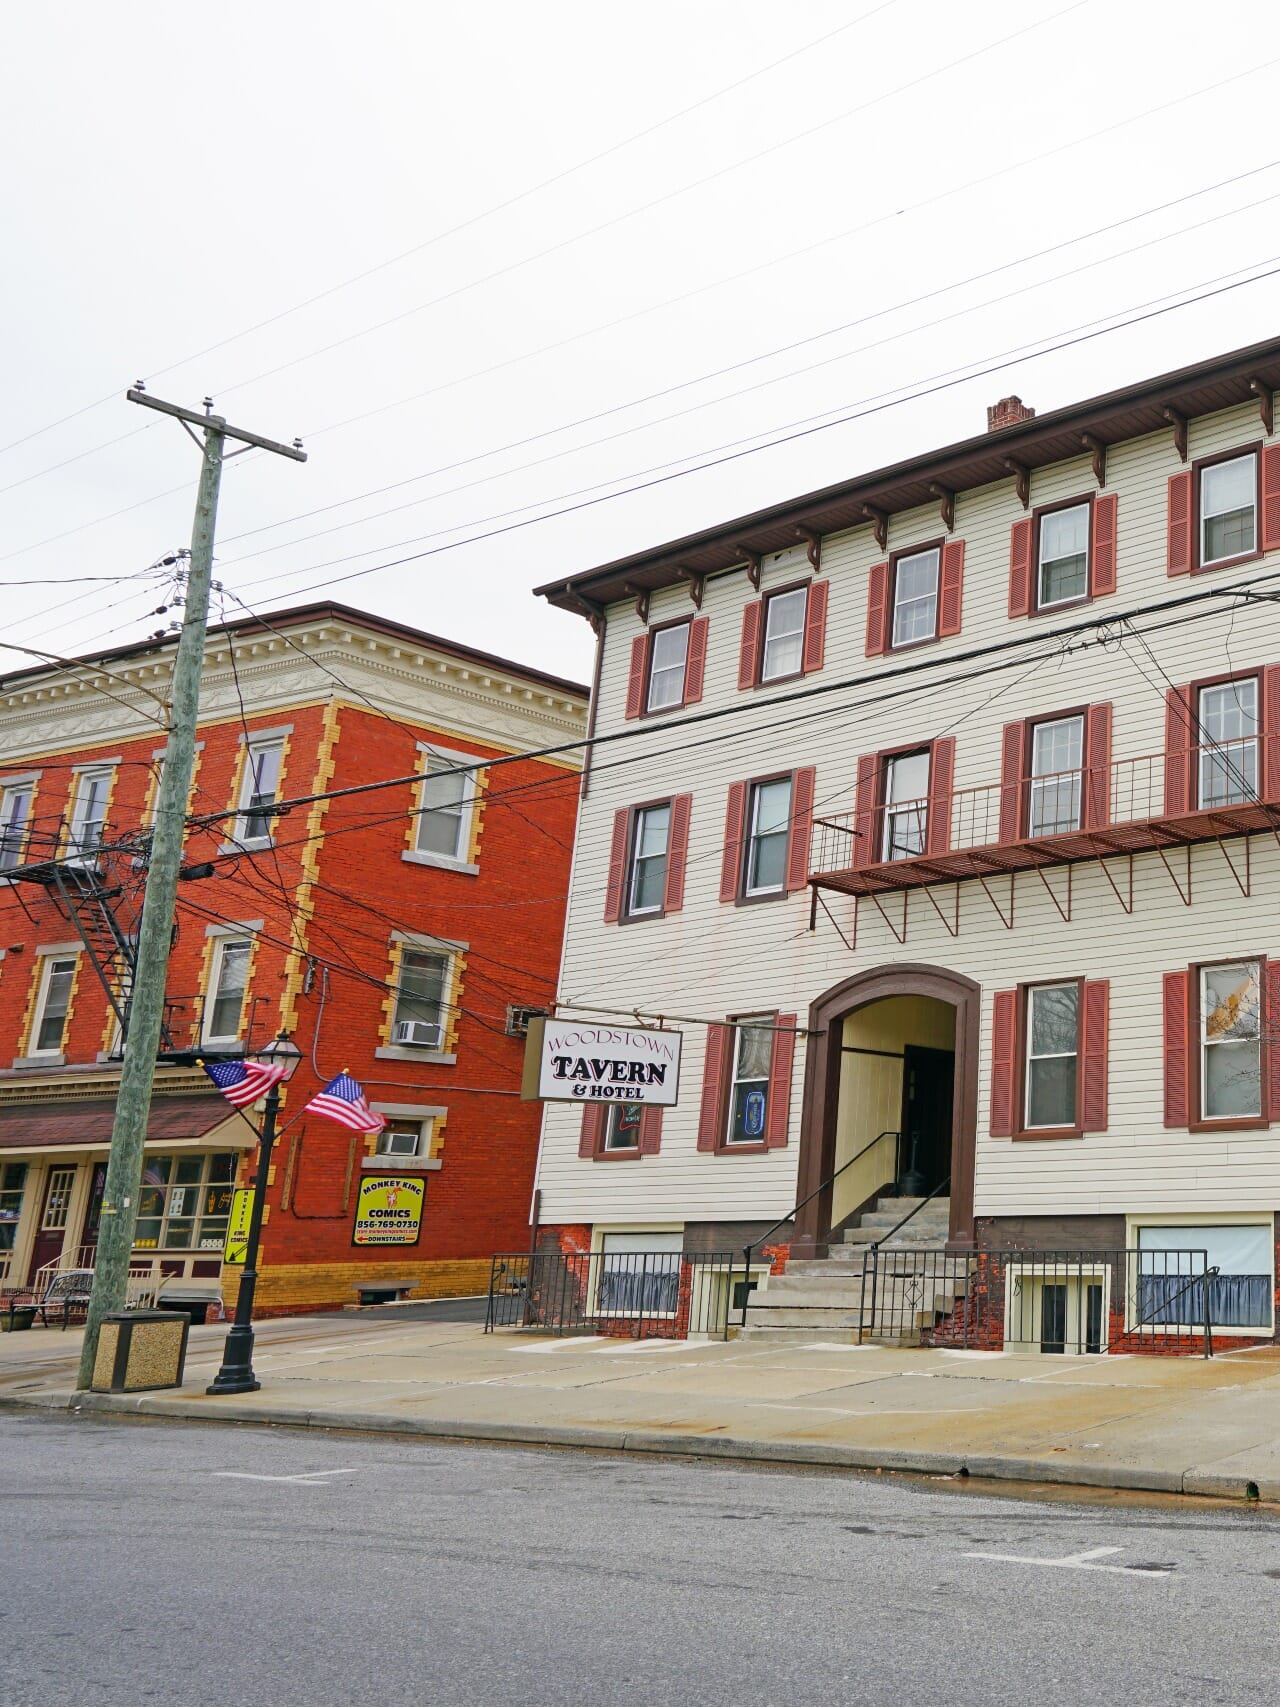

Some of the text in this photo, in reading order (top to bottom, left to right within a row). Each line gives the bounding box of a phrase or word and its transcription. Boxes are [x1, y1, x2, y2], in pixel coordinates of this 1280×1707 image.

[548, 1029, 674, 1061] WOODSTOWN
[551, 1055, 668, 1086] TAVERN
[572, 1083, 645, 1099] & HOTEL
[363, 1180, 422, 1196] MONKEY KING
[368, 1209, 411, 1218] COMICS
[357, 1220, 419, 1228] 856-769-0730
